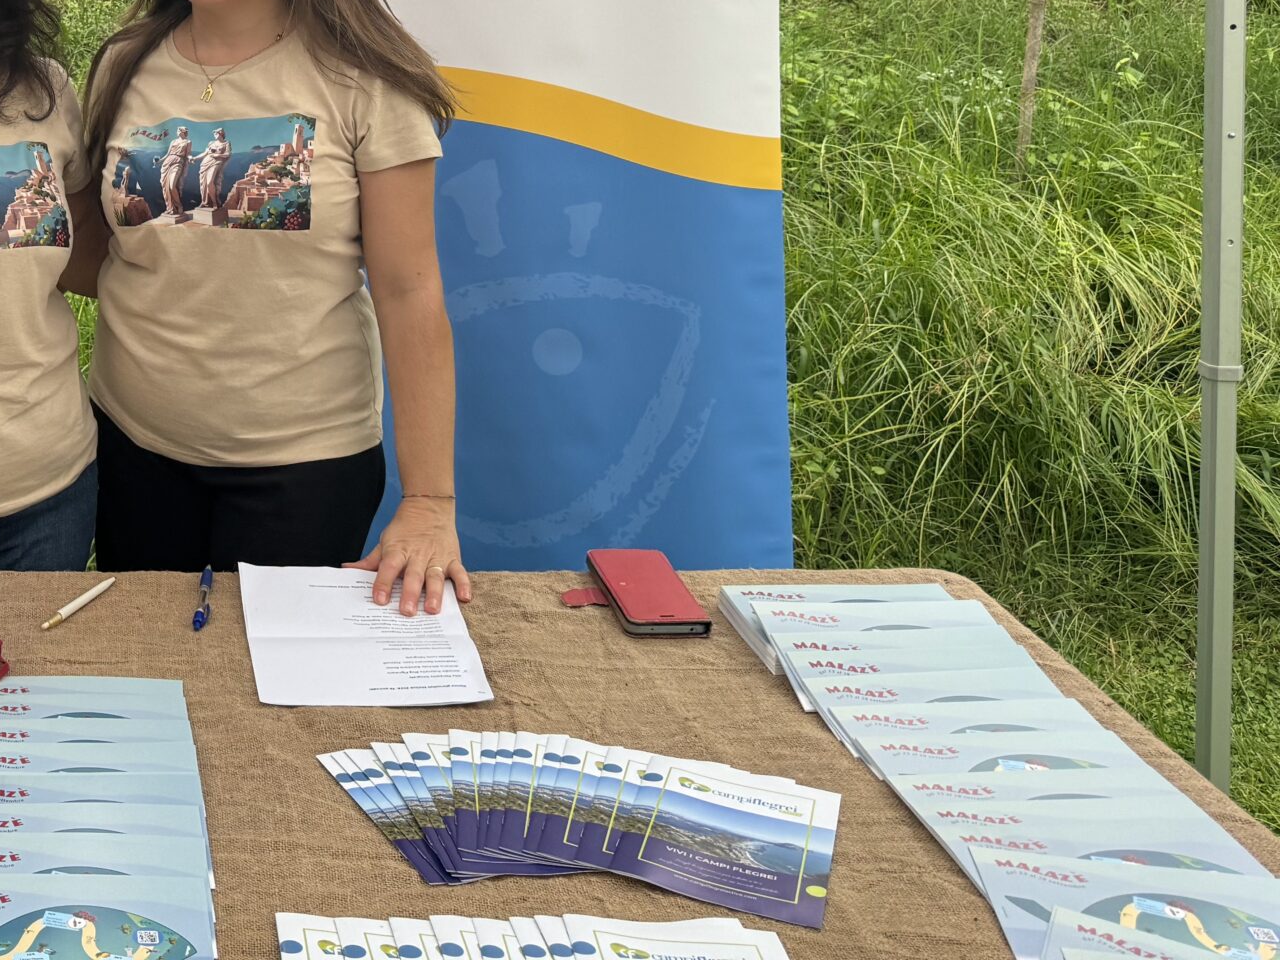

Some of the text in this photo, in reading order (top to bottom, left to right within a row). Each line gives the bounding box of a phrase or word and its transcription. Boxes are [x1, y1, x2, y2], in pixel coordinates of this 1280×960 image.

[666, 845, 687, 857] VIVI
[695, 856, 730, 870] CAMPI
[733, 866, 778, 881] FLEGREI
